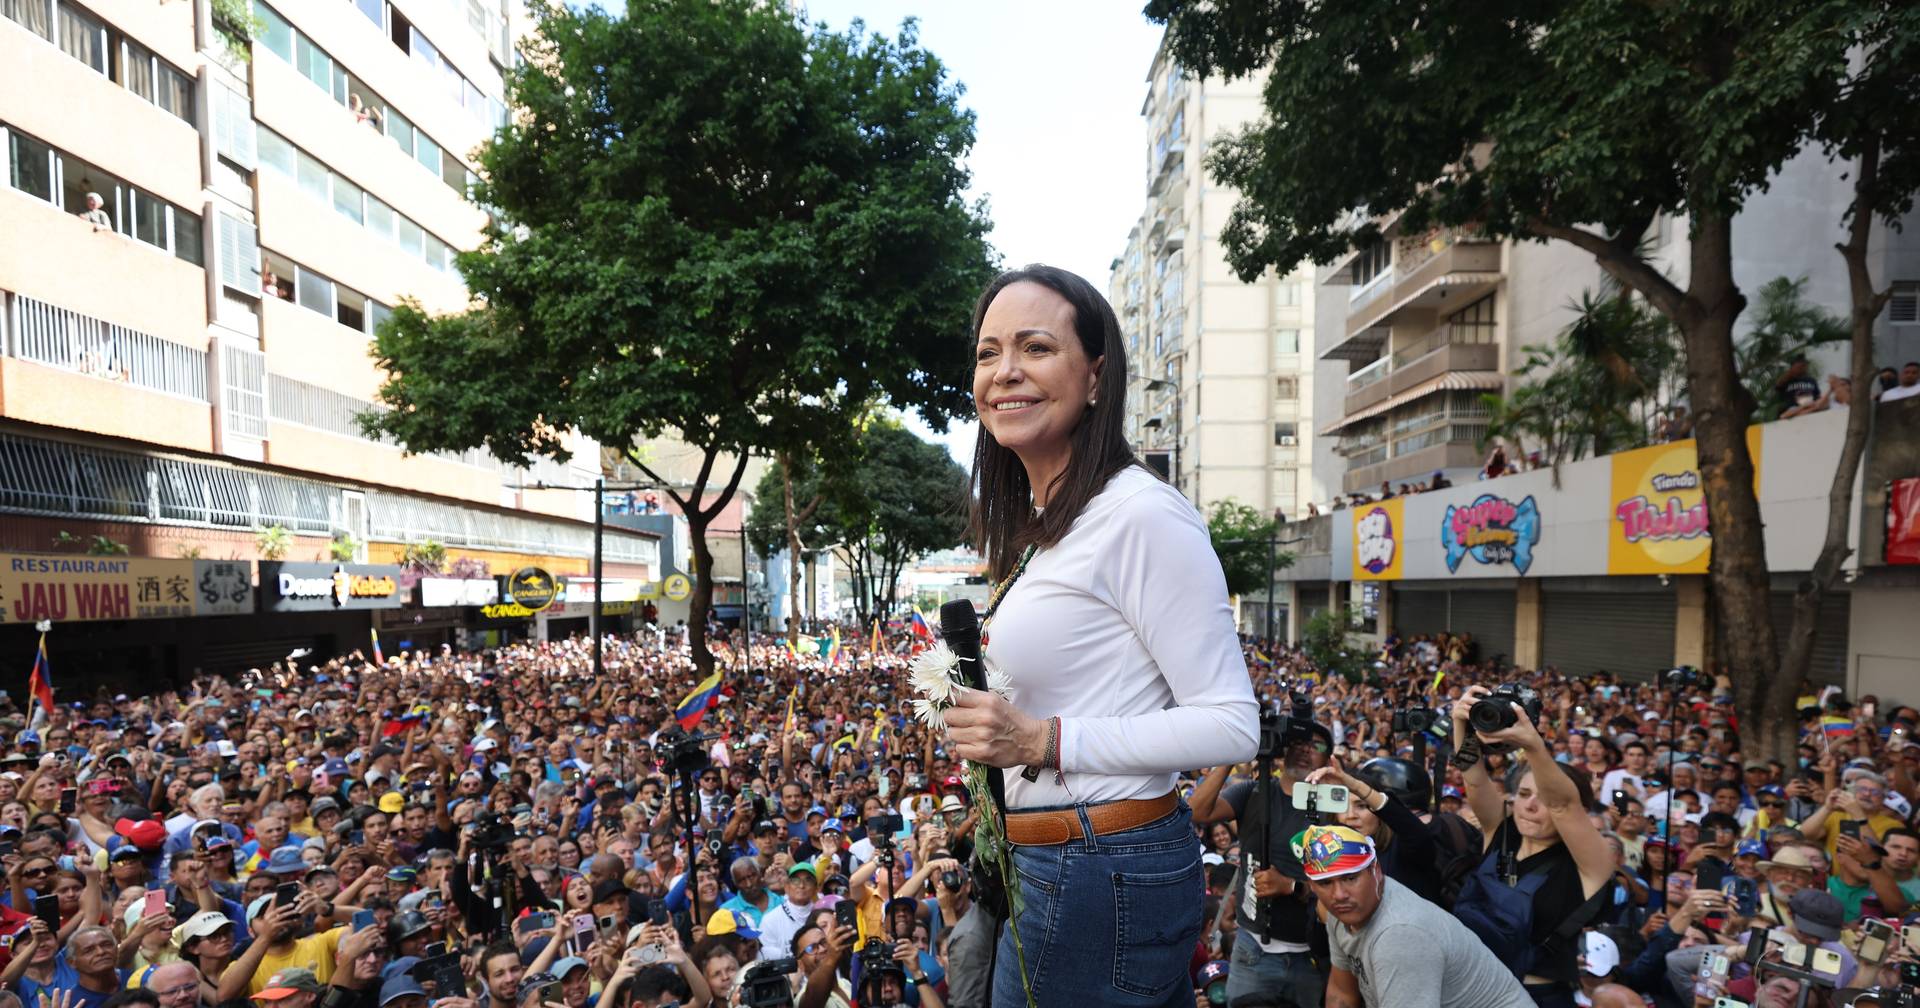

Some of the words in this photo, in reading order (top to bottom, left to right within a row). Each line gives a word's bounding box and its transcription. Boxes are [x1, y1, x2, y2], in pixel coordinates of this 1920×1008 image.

[11, 558, 129, 573] RESTAURANT
[136, 574, 190, 603] 酒家
[349, 575, 396, 597] Kebab
[14, 582, 67, 621] JAU
[73, 583, 131, 619] WAH
